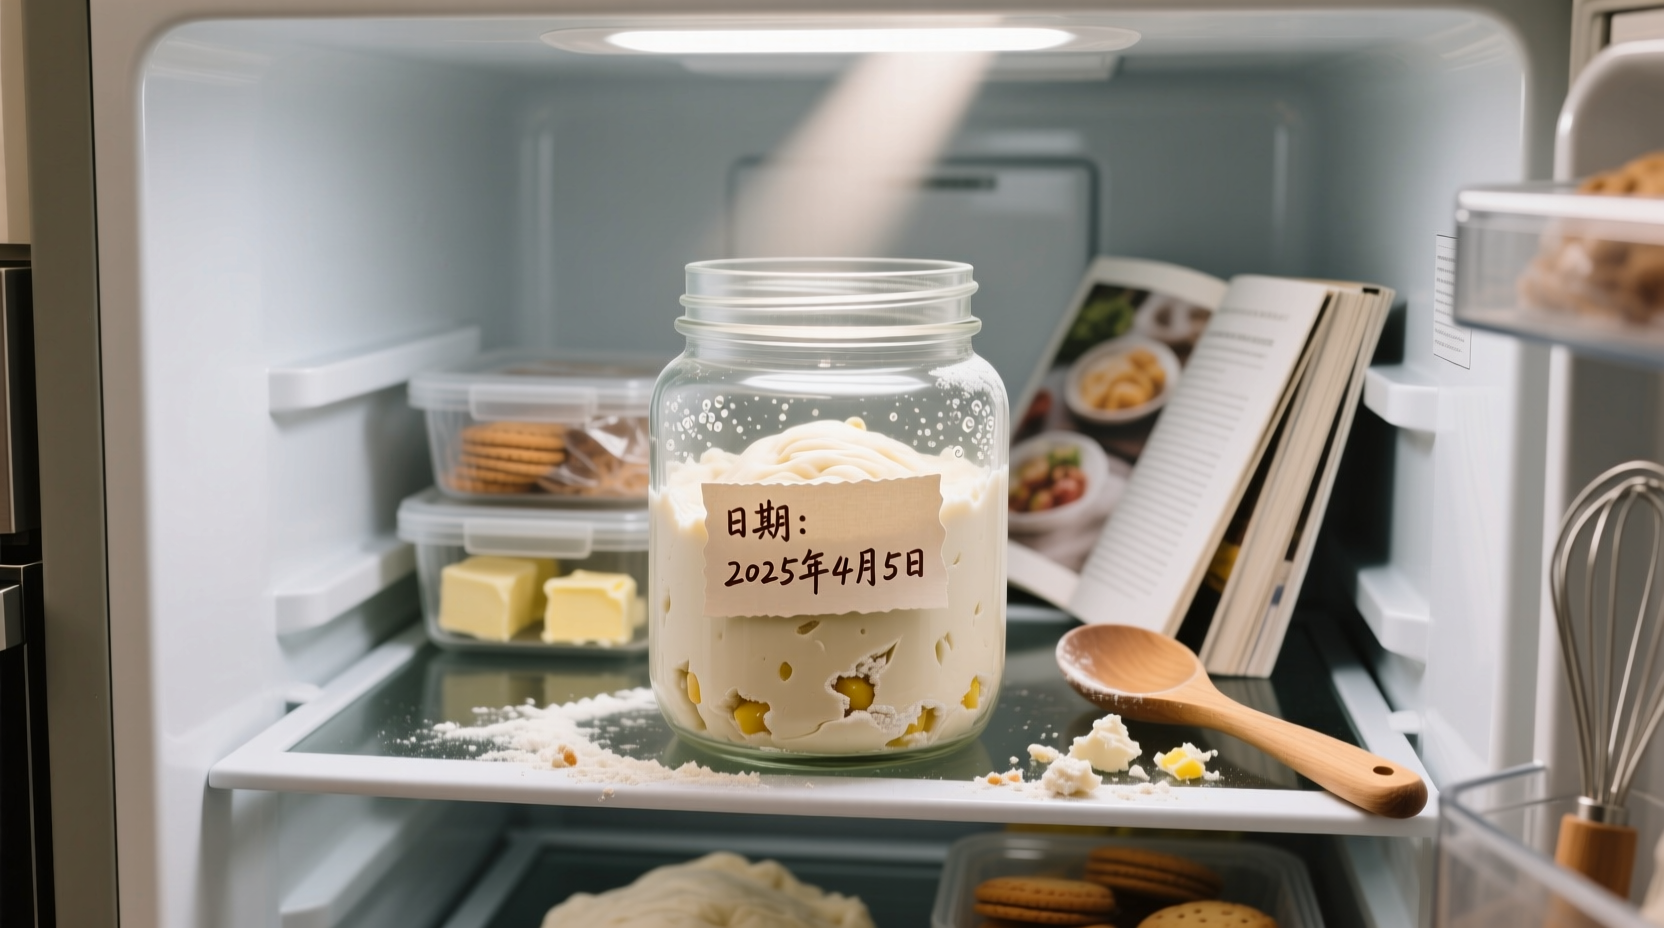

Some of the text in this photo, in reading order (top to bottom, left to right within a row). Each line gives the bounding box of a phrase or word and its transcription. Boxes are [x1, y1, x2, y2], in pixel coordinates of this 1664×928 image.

[727, 499, 807, 543] 日期：
[724, 547, 924, 596] 2025年4月5日
